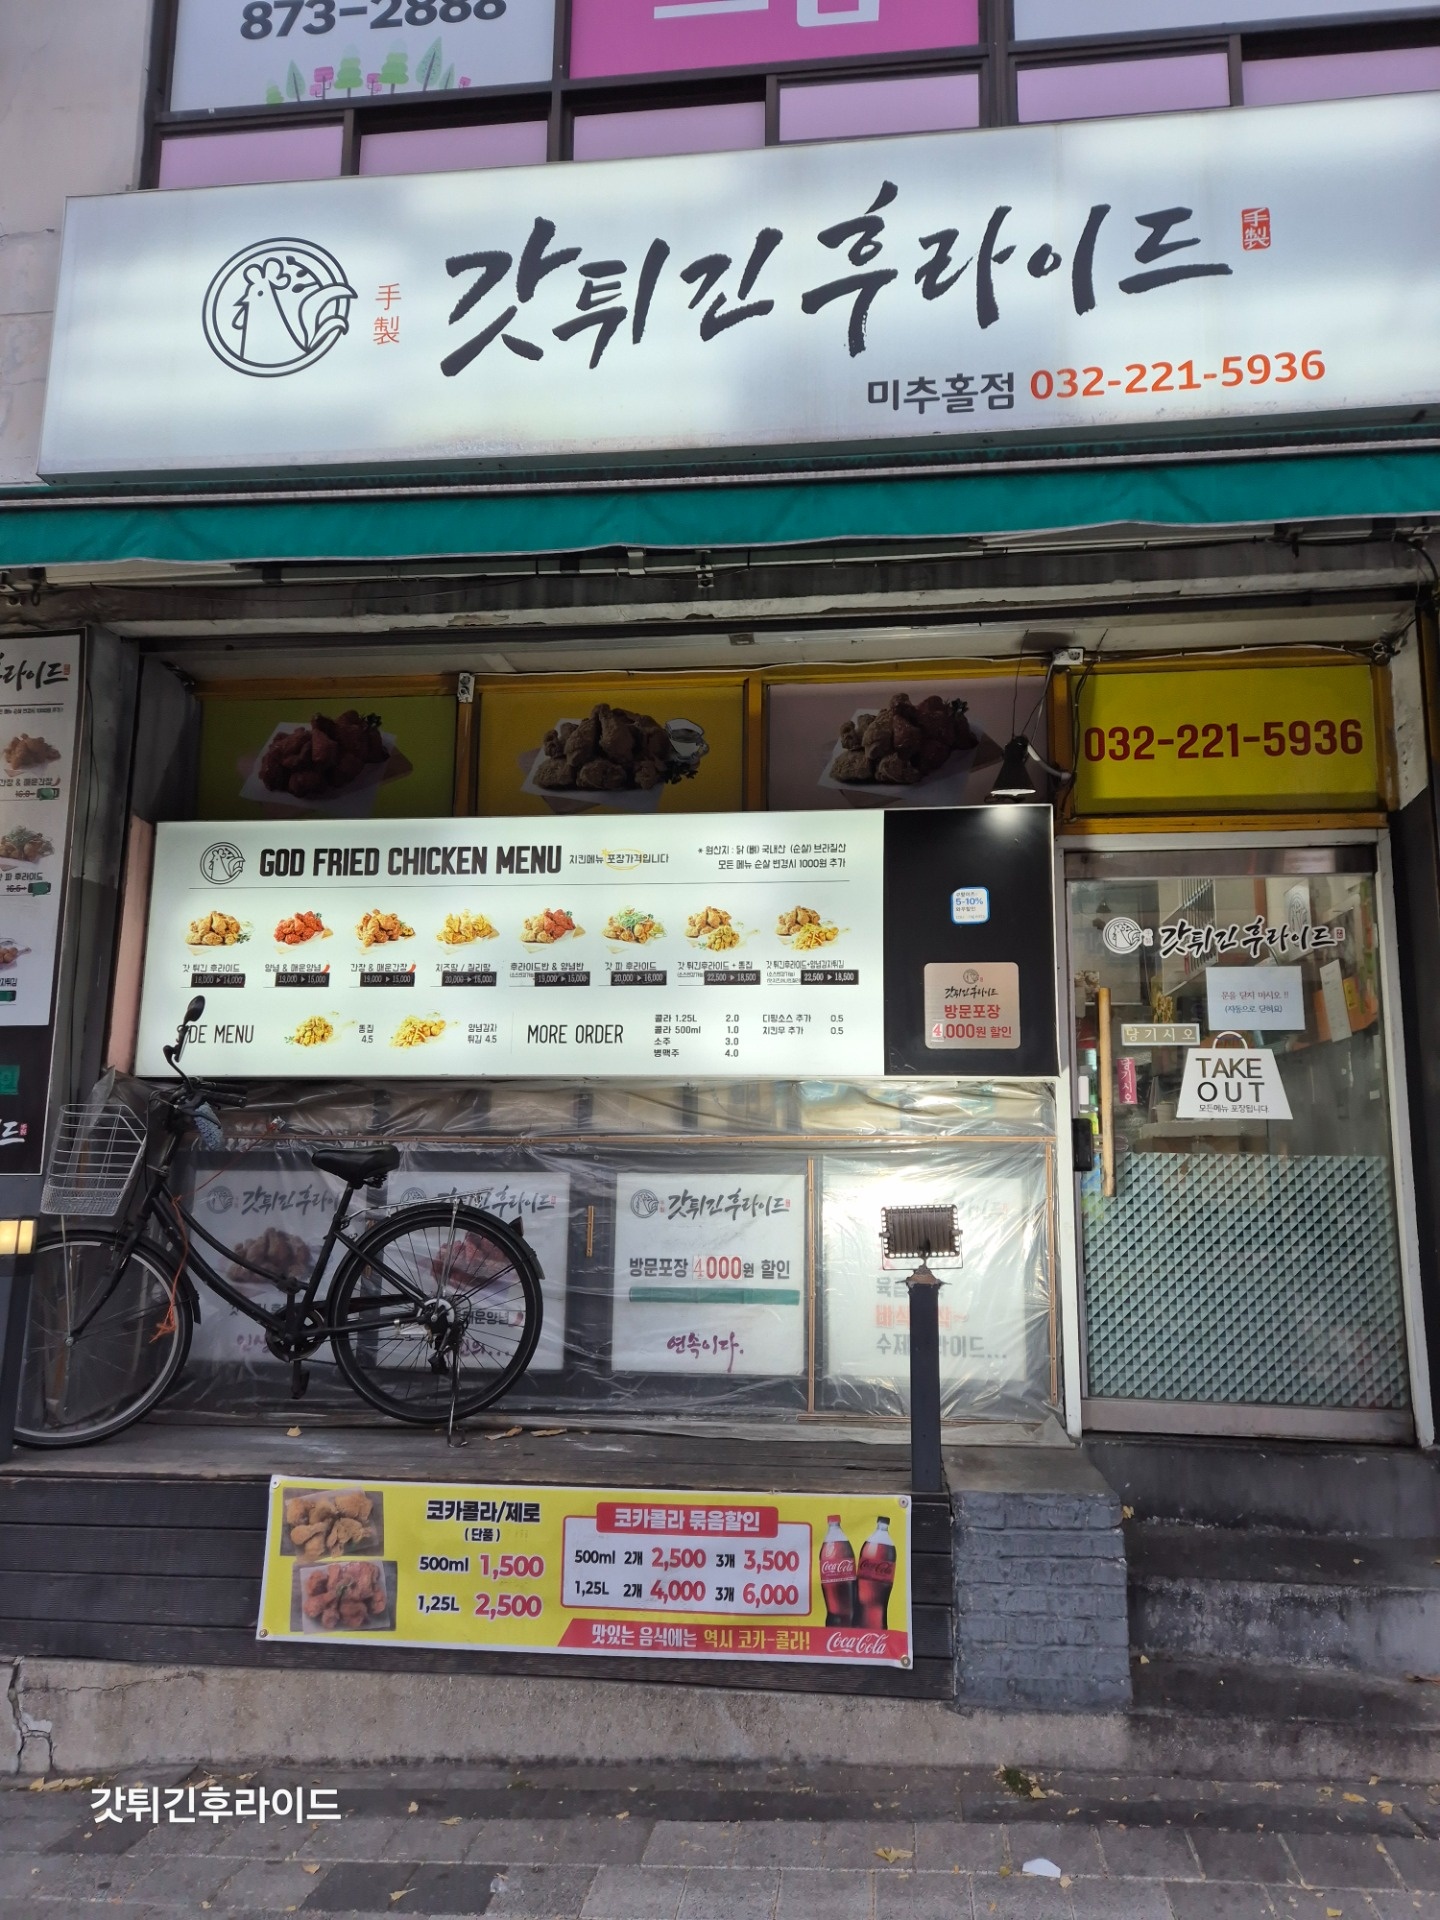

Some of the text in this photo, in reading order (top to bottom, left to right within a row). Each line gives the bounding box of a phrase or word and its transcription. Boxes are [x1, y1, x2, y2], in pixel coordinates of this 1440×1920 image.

[440, 180, 1233, 377] 갓튀긴후라이드
[867, 350, 1326, 415] 미추홀점 032-221-5936
[0, 653, 68, 691] 라이드
[1084, 719, 1363, 762] 032-221-5936
[762, 844, 786, 855] 국내산
[814, 843, 846, 854] 브라질산
[259, 845, 562, 877] GOD FRIED CHICKEN MENU
[607, 853, 669, 864] 포장가격입니다
[718, 859, 734, 870] 모든
[736, 859, 753, 870] 메뉴
[773, 859, 797, 869] 변경시
[799, 858, 828, 868] 1000원
[829, 858, 846, 868] 추가
[955, 898, 984, 906] 5-10%
[1160, 917, 1336, 957] 갓튀긴후라이드
[210, 963, 240, 972] 후라이드
[510, 962, 549, 972] 후라이드반
[625, 962, 657, 971] 후라이드
[804, 972, 825, 981] 22,500
[834, 972, 855, 981] 18,500
[1258, 991, 1281, 1000] 마시오
[944, 1004, 1001, 1019] 방문포장
[1225, 1004, 1257, 1014] (자동으로
[654, 1014, 698, 1024] 콜라 1.25L
[725, 1014, 740, 1023] 2.0
[796, 1014, 812, 1024] 추가
[830, 1014, 844, 1023] 0.5
[214, 1024, 254, 1044] MENU
[527, 1024, 624, 1044] MORE ORDER
[654, 1025, 701, 1035] 콜라 500ml
[727, 1026, 740, 1034] 1.0
[787, 1026, 804, 1035] 추가
[830, 1026, 844, 1035] 0.5
[990, 1026, 1012, 1039] 할인
[361, 1035, 374, 1043] 4.5
[485, 1034, 498, 1043] 4.5
[654, 1036, 671, 1046] 소주
[725, 1037, 739, 1046] 3.0
[654, 1048, 680, 1058] 병맥주
[725, 1048, 739, 1058] 4.0
[1195, 1058, 1263, 1079] TAKE
[1197, 1081, 1265, 1103] OUT
[1199, 1104, 1229, 1113] 모든메뉴
[241, 1184, 340, 1216] 갓튀긴후라이
[667, 1188, 790, 1221] 갓튀긴후라이드
[629, 1256, 790, 1280] 방문포장 4000원 할인
[427, 1500, 541, 1524] 코카콜라/제로
[614, 1507, 761, 1533] 코카콜라 묶음할인
[574, 1548, 800, 1573] 500ml 2개 2,500 3개 3,500
[419, 1554, 545, 1580] 500ml 1,500
[574, 1580, 800, 1608] 1,25L 2개 4,000 3개 6,000
[417, 1593, 543, 1620] 1,25L 2,500
[591, 1624, 635, 1646] 맛있는
[638, 1627, 697, 1648] 음식에는
[703, 1629, 733, 1649] 역시
